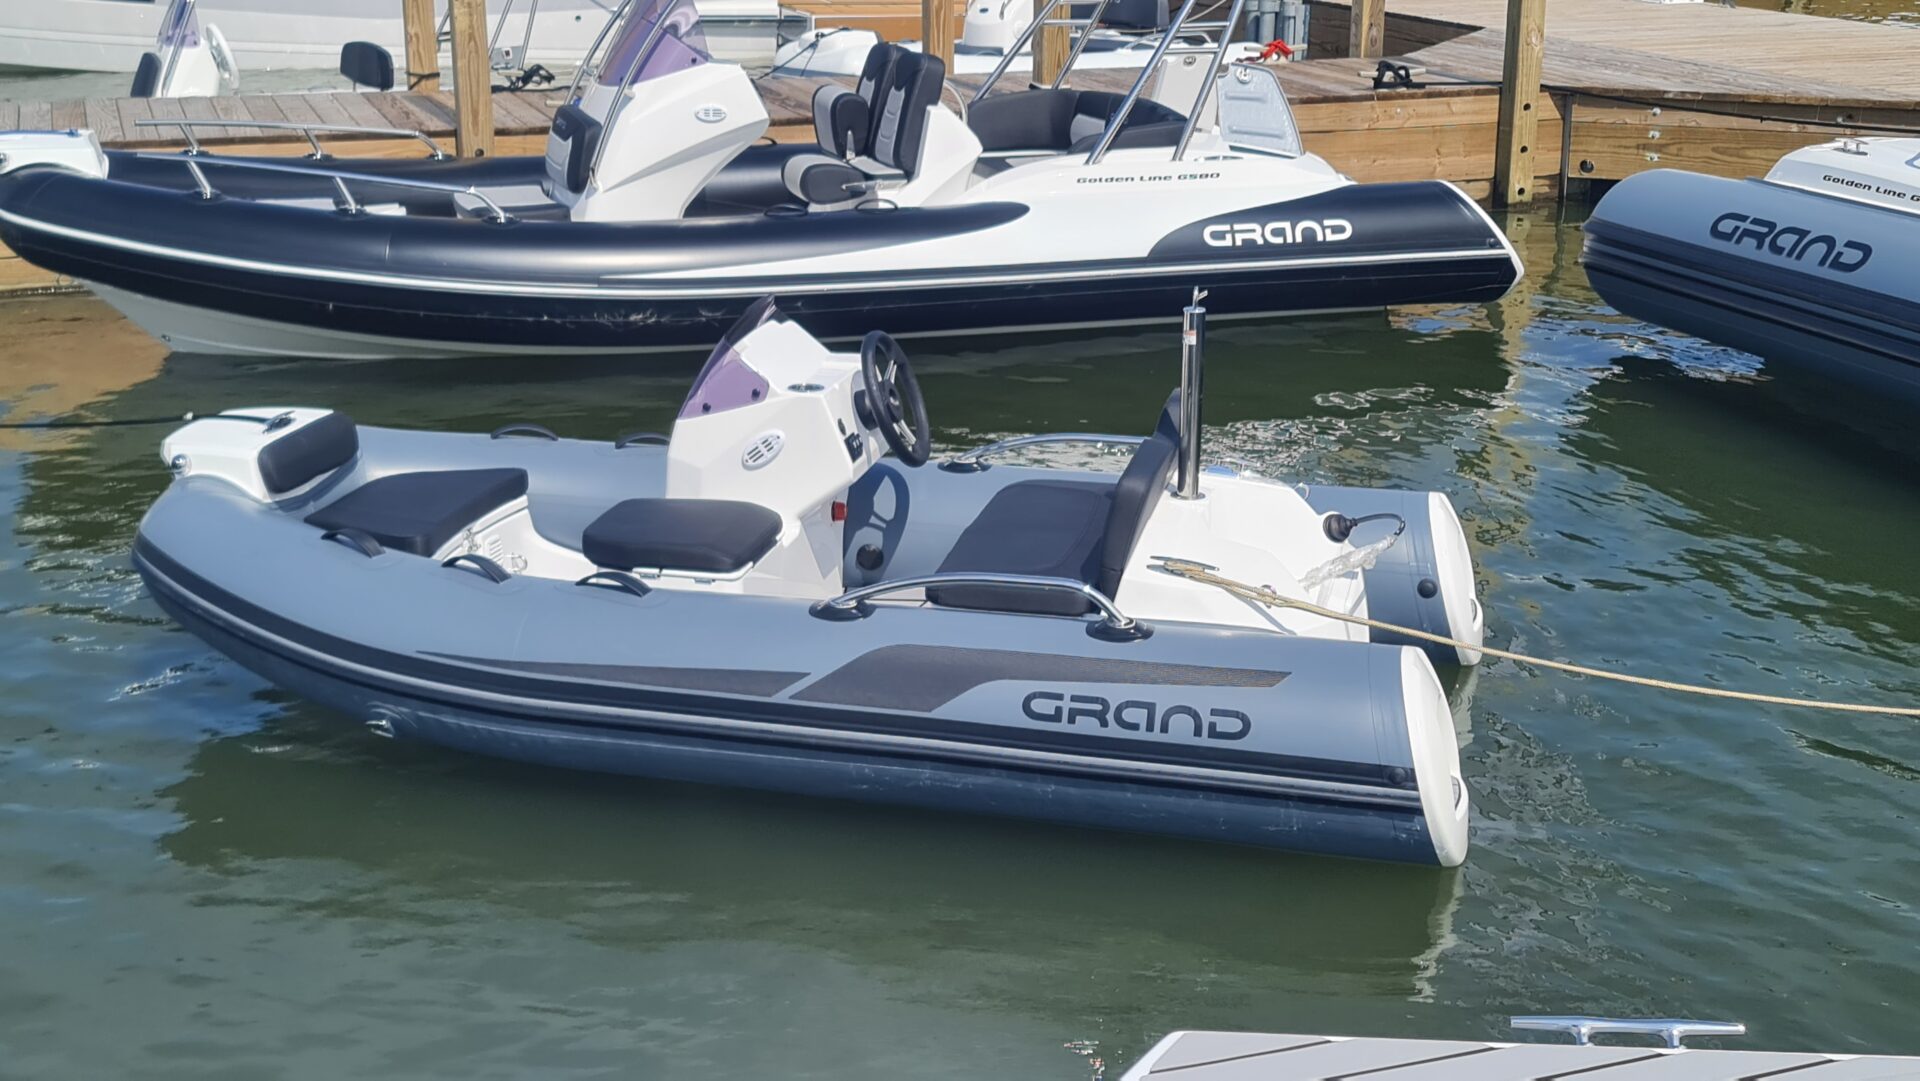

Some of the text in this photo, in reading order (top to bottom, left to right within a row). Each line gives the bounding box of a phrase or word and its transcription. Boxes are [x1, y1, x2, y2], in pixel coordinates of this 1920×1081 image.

[1076, 175, 1135, 184] Golden
[1139, 174, 1173, 182] Line
[1822, 174, 1872, 191] Golden
[1875, 186, 1907, 199] Line
[1203, 218, 1353, 247] GRAND
[1709, 212, 1873, 273] GRAND
[1021, 691, 1252, 741] GRAND
